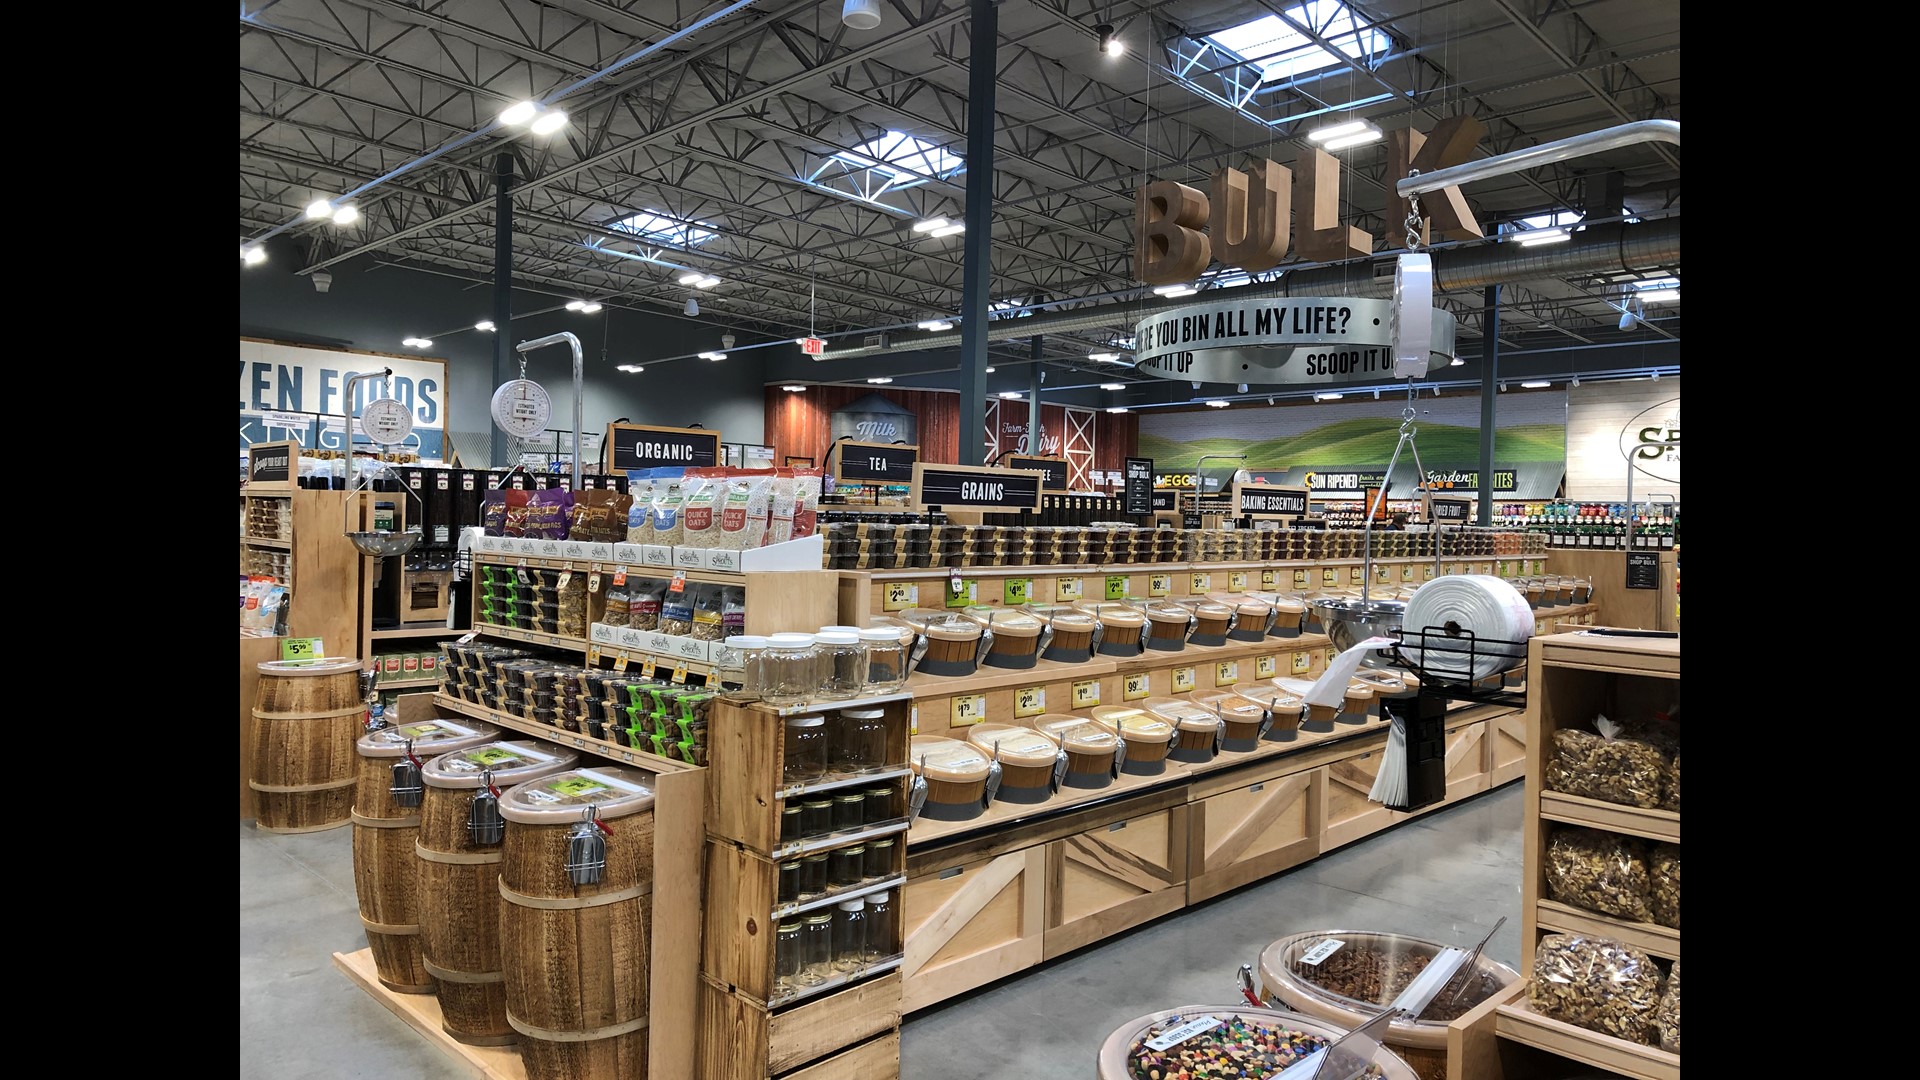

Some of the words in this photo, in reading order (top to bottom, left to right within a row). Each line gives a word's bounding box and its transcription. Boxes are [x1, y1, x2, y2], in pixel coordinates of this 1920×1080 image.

[1134, 114, 1486, 283] BULK
[1156, 319, 1178, 347] YOU
[1182, 314, 1209, 342] BIN
[1214, 310, 1249, 338] ALL
[1255, 307, 1287, 335] MY
[1293, 306, 1351, 334] LIFE?
[806, 340, 821, 353] EXIT
[1178, 352, 1193, 373] UP
[1307, 351, 1359, 376] SCOOP
[1364, 349, 1377, 372] IT
[1382, 347, 1394, 370] U
[856, 421, 897, 439] Milk
[636, 441, 693, 461] ORGANIC
[1015, 432, 1061, 457] Diry
[869, 456, 887, 471] TEA
[1128, 470, 1139, 478] SHOP
[1139, 471, 1150, 479] BULK
[1311, 474, 1326, 489] SUN
[1327, 474, 1358, 489] RIPENED
[1427, 470, 1470, 484] Garden
[1469, 473, 1513, 488] FAITES
[961, 481, 1004, 501] GRAINS
[1241, 495, 1266, 510] BAKING
[1267, 496, 1304, 512] ESSENTIALS
[1449, 505, 1462, 517] FRUIT
[687, 510, 708, 518] QUICK
[688, 518, 706, 527] OATS
